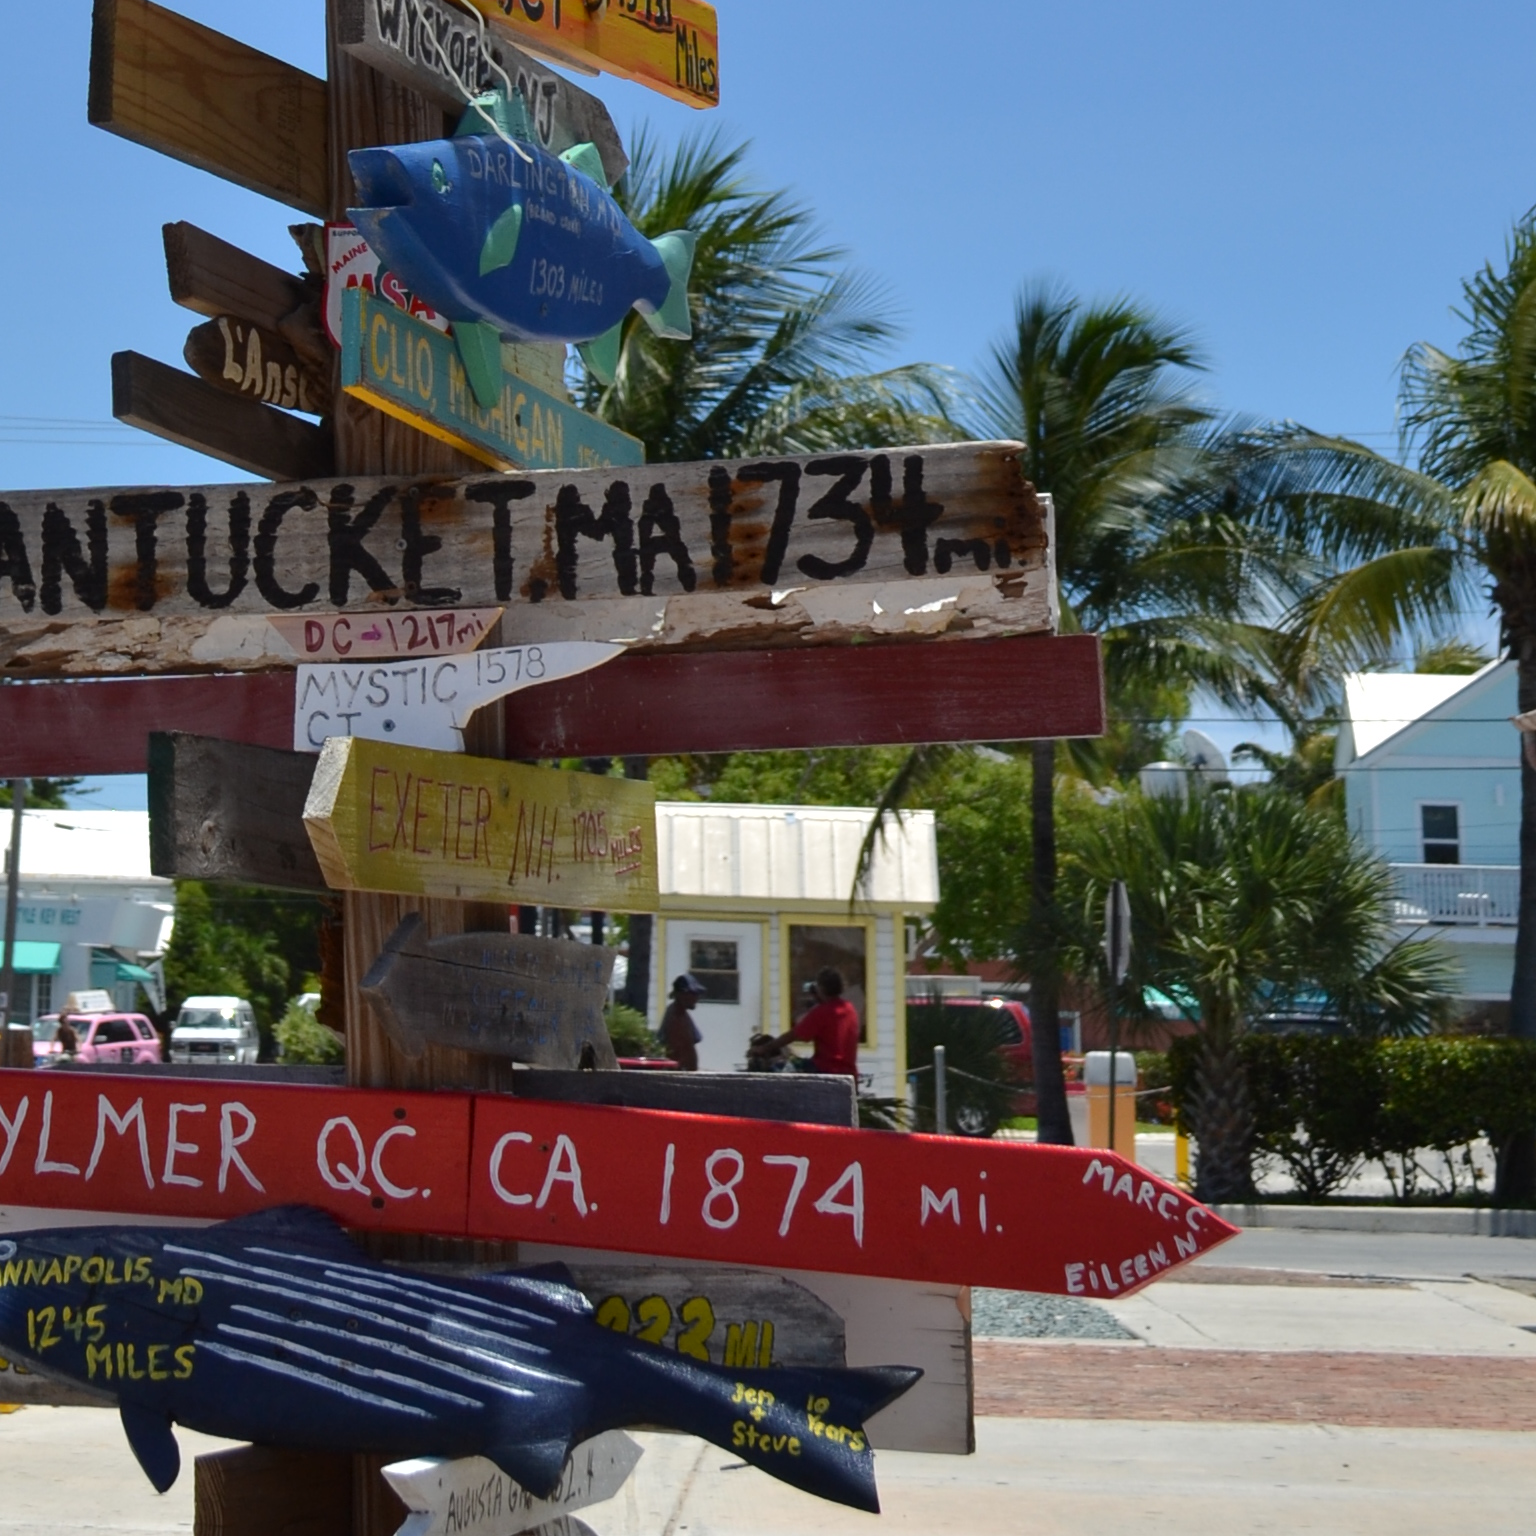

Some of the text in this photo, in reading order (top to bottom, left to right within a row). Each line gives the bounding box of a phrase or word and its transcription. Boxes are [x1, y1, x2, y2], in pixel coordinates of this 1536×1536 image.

[675, 23, 716, 92] Miles
[331, 241, 368, 275] MAINE
[529, 257, 565, 299] 1303
[556, 479, 697, 600] MA
[303, 618, 354, 655] DC
[299, 646, 548, 712] MYSTIC 1578
[306, 709, 363, 747] CT
[369, 766, 492, 867] EXETER
[572, 810, 609, 863] 1705
[658, 1142, 865, 1248] 1874
[156, 1276, 205, 1306] MD
[26, 1303, 108, 1349] 1245
[85, 1344, 197, 1381] MILES
[731, 1382, 776, 1408] Jen
[732, 1420, 802, 1457] Steve
[806, 1412, 866, 1452] Years
